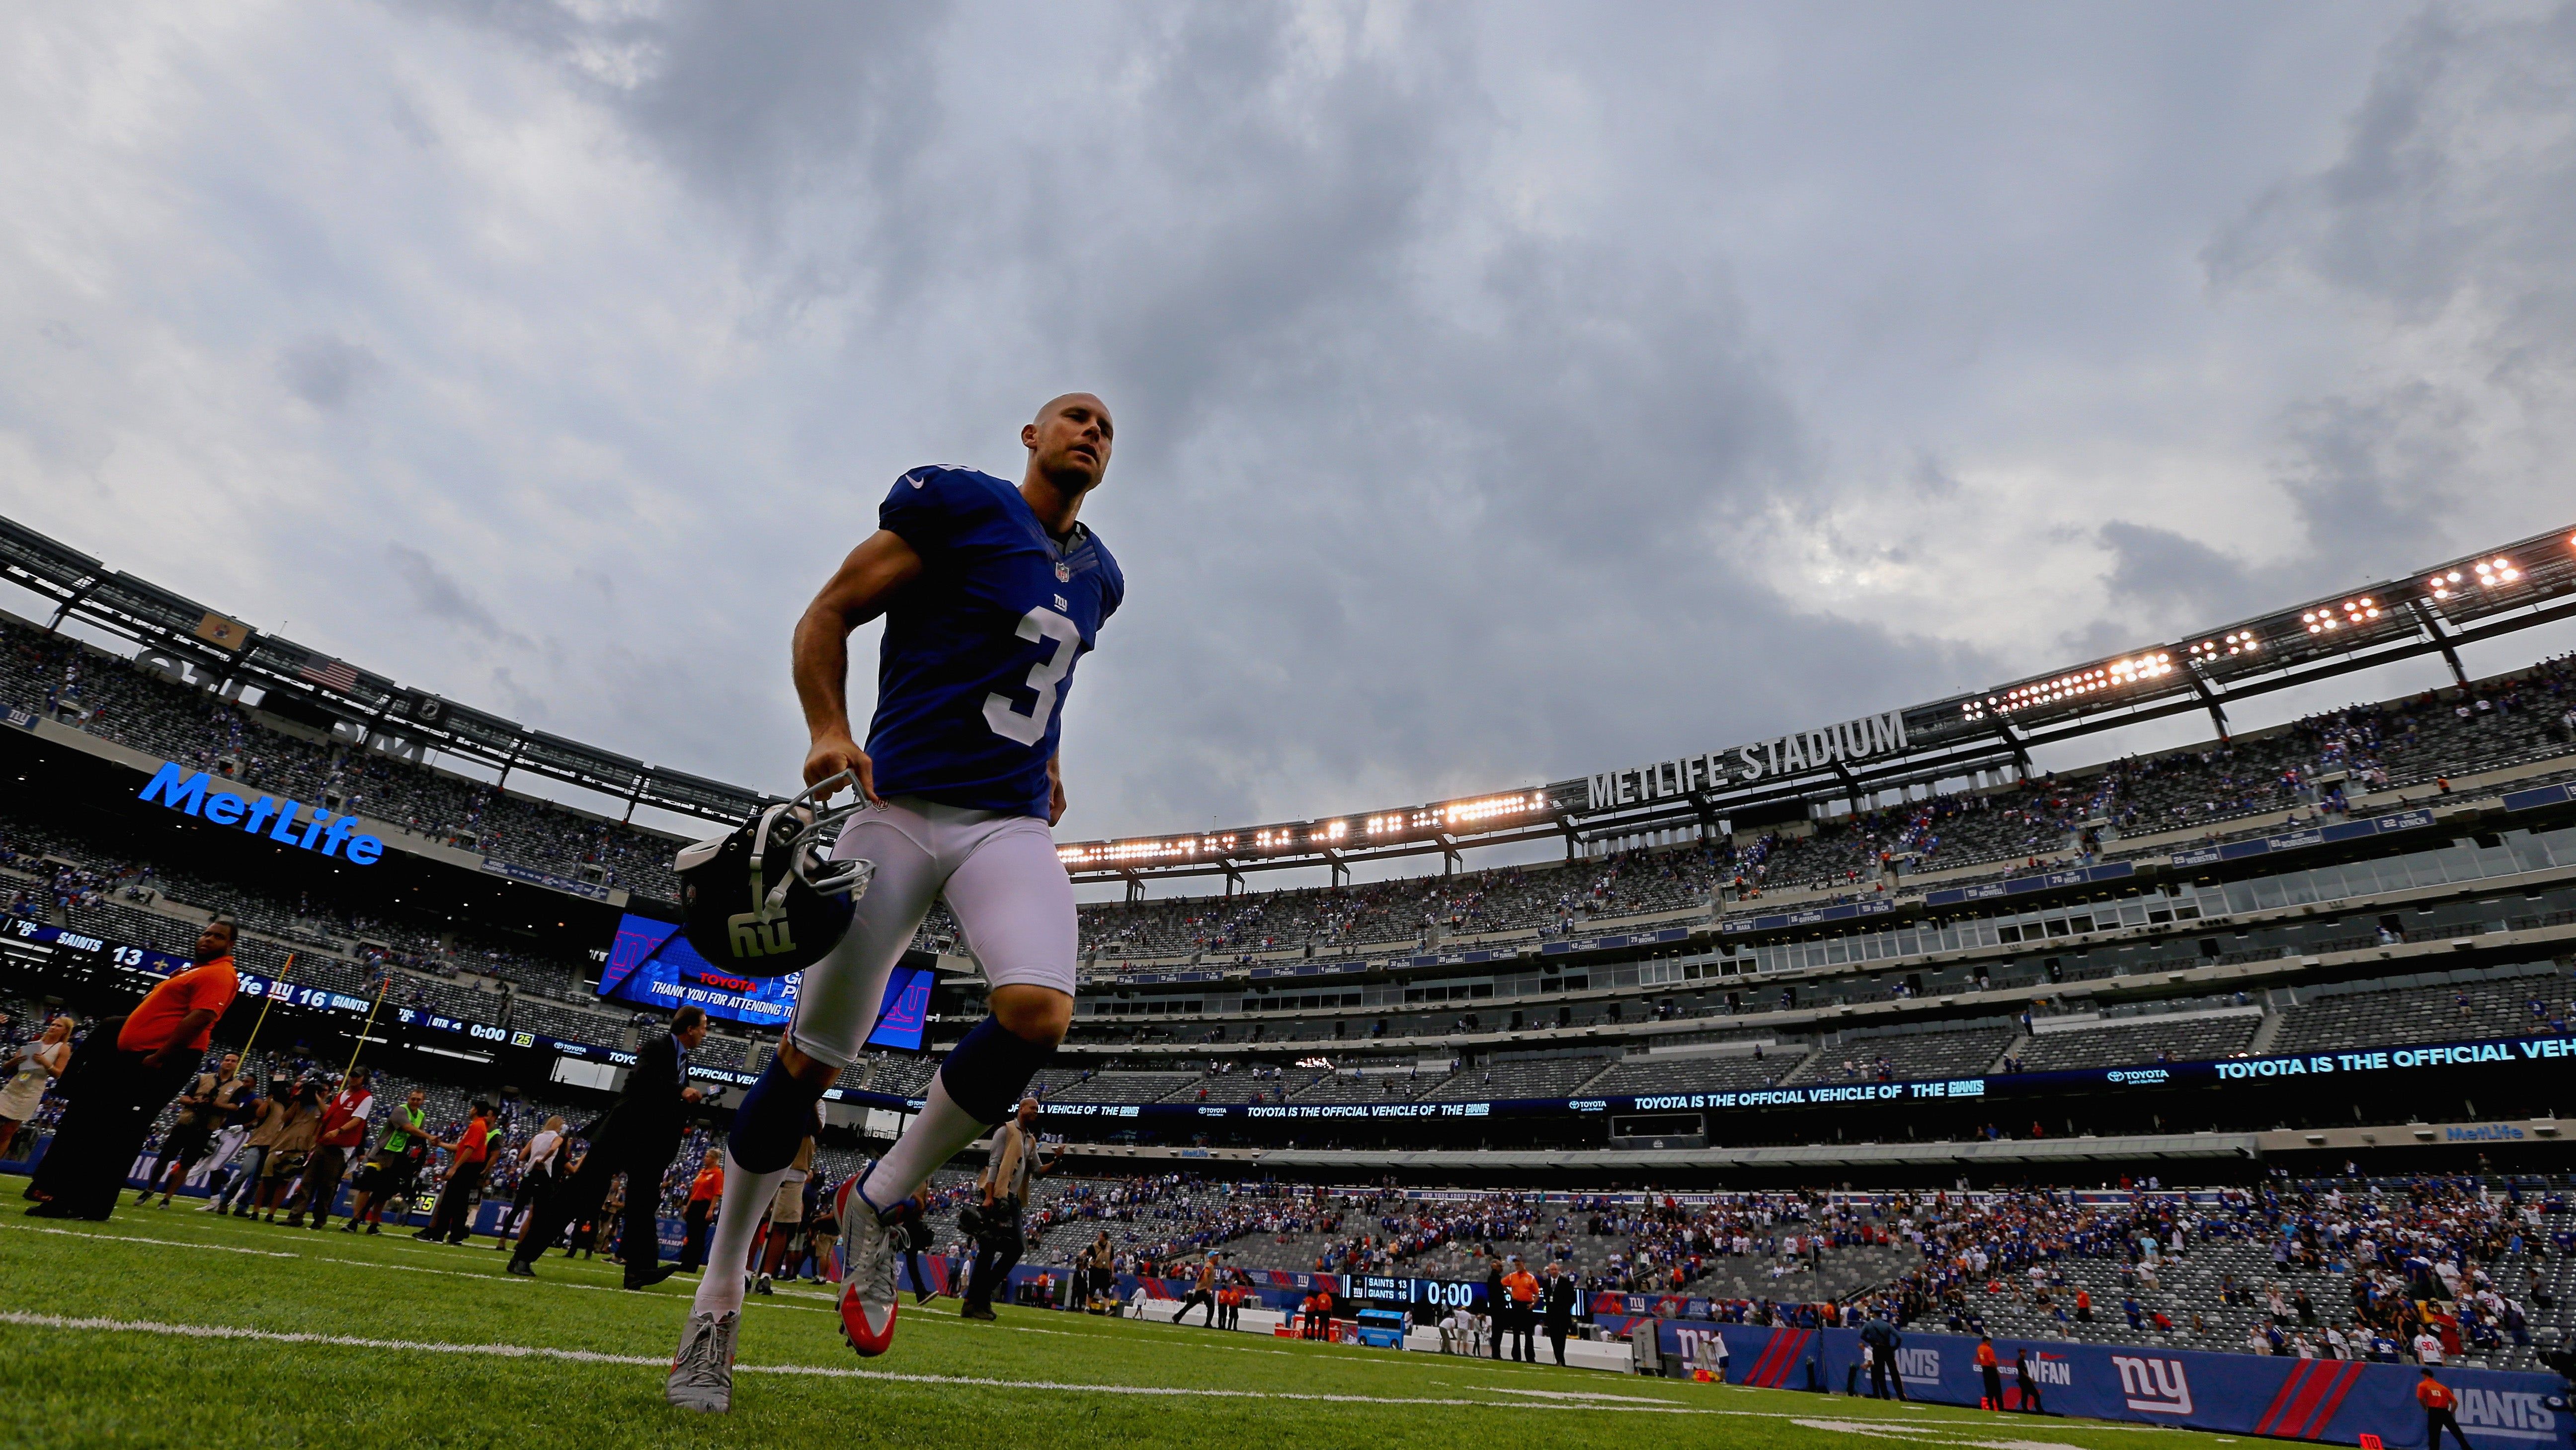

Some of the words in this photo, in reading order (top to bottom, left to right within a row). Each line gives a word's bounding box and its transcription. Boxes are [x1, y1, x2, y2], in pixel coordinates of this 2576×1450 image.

[982, 606, 1081, 747] 3
[1588, 749, 1729, 810] METLIFE
[1740, 709, 1909, 780] STADIUM
[138, 761, 384, 866] MetLife
[2381, 819, 2397, 828] 22
[2399, 817, 2427, 829] LYNCH
[2174, 856, 2185, 864] 29
[2185, 853, 2218, 865] WEBSTER
[2064, 875, 2081, 884] HUFF
[1979, 888, 2004, 897] HOWELL
[16, 920, 37, 931] TOL
[56, 932, 103, 952] SAINTS
[113, 946, 144, 966] 13
[700, 972, 757, 993] TOYOTA
[299, 989, 327, 1007] 16
[330, 995, 370, 1012] GIANTS
[651, 981, 688, 998] THANK
[686, 988, 709, 1002] YOU
[707, 992, 727, 1006] FOR
[726, 996, 783, 1016] ATTENDING
[399, 1008, 415, 1018] TOL
[470, 1024, 506, 1041] 0:00
[516, 1035, 531, 1045] 25
[564, 1044, 587, 1053] TOYOTA
[2215, 1059, 2307, 1079] TOYOTA
[2311, 1057, 2334, 1073] IS
[2338, 1053, 2389, 1071] THE
[2393, 1044, 2516, 1067] OFFICIAL
[688, 1067, 735, 1082] OFFICIAL
[2124, 1069, 2170, 1080] TOYOTA
[1635, 1096, 1688, 1110] TOYOTA
[1691, 1095, 1704, 1108] IS
[1707, 1094, 1736, 1107] THE
[1738, 1090, 1805, 1106] OFFICIAL
[1809, 1086, 1875, 1102] VEHICLE
[1878, 1085, 1902, 1099] OF
[1911, 1083, 1945, 1097] THE
[1948, 1080, 1985, 1097] GIANTS
[1047, 1105, 1083, 1115] VEHICLE
[1084, 1105, 1097, 1115] OF
[1101, 1106, 1119, 1116] THE
[1119, 1106, 1139, 1116] GIANTS
[1247, 1107, 1286, 1117] TOYOTA
[1288, 1107, 1297, 1117] IS
[1300, 1107, 1320, 1117] THE
[1321, 1106, 1369, 1117] OFFICIAL
[1372, 1105, 1417, 1117] VEHICLE
[1419, 1104, 1436, 1116] OF
[1441, 1104, 1464, 1116] THE
[1464, 1103, 1490, 1116] GIANTS
[2446, 1124, 2524, 1141] MetLife
[1182, 1149, 1208, 1158] MetLife
[1297, 1275, 1309, 1287] ny
[1368, 1278, 1394, 1288] SAINTS
[1398, 1280, 1407, 1289] 13
[1368, 1290, 1394, 1299] GIANTS
[1398, 1291, 1407, 1300] 16
[1428, 1282, 1472, 1307] 0:00
[2485, 1297, 2495, 1307] 21
[1629, 1297, 1645, 1312] ny
[2421, 1342, 2434, 1351] 90
[2024, 1351, 2071, 1385] WFAN
[2112, 1355, 2193, 1415] ny
[2452, 1388, 2558, 1437] IANTS
[2364, 1436, 2379, 1449] 10
